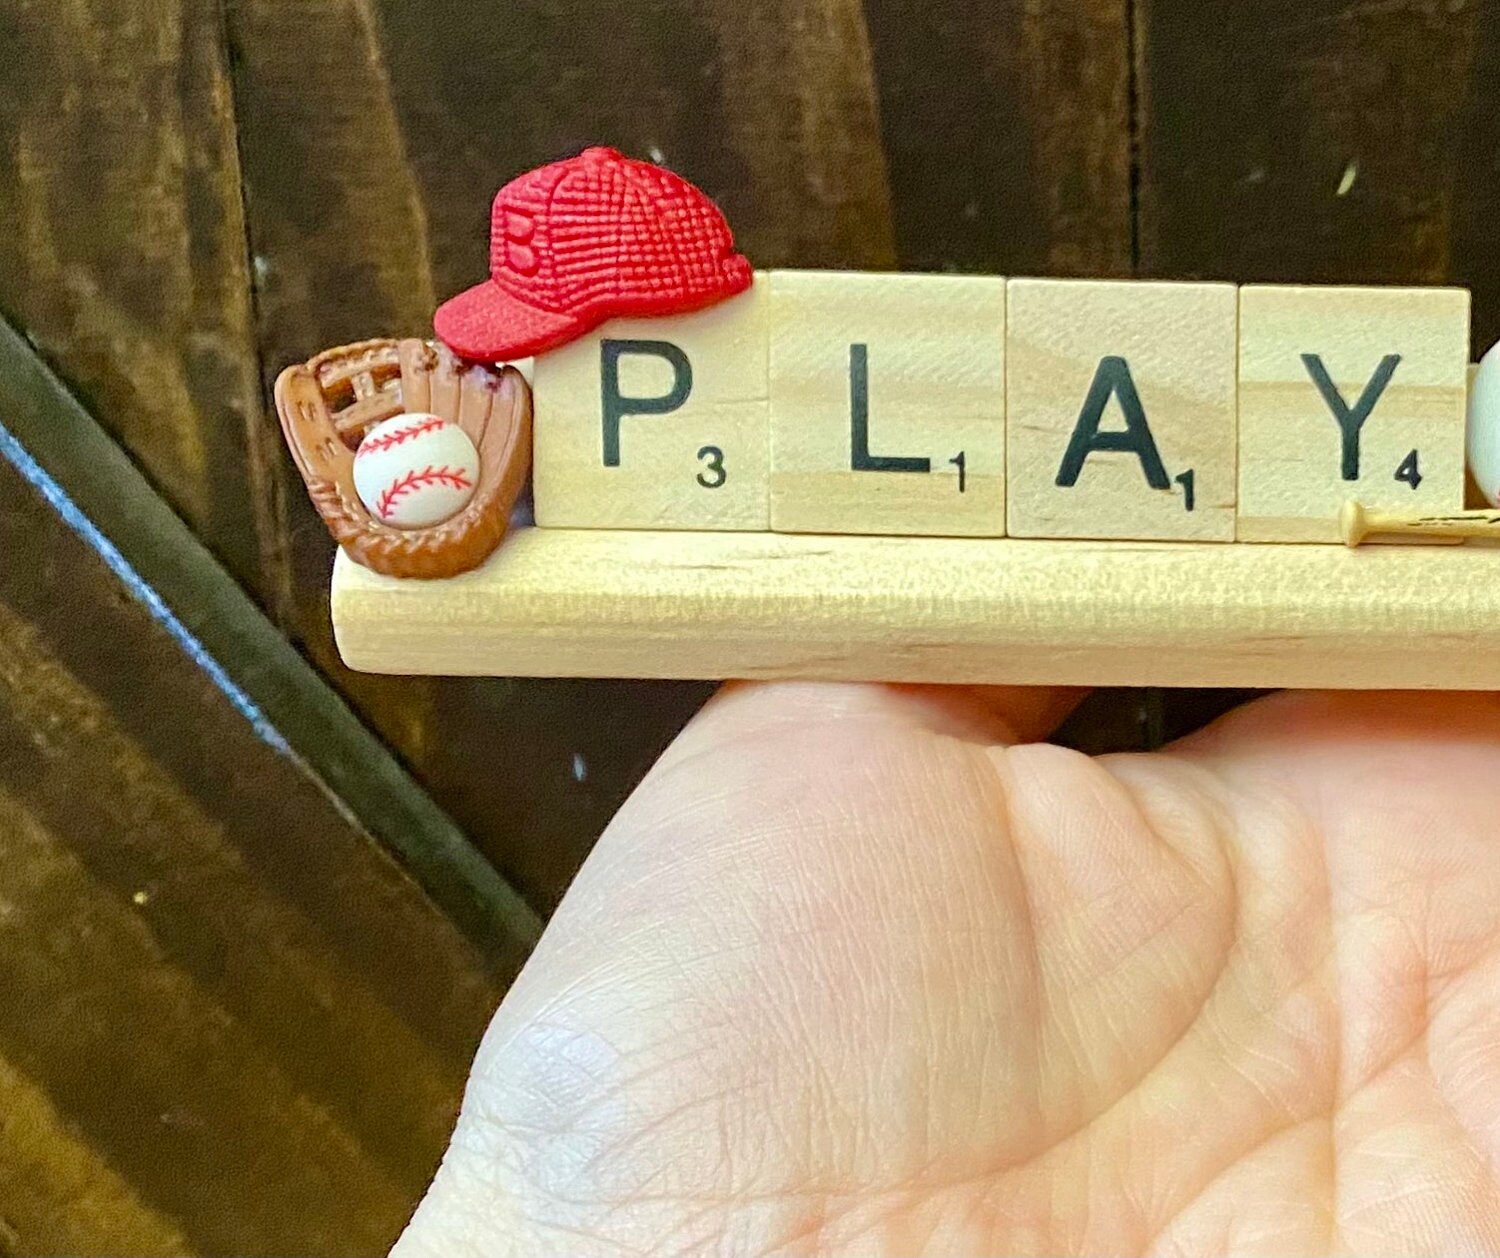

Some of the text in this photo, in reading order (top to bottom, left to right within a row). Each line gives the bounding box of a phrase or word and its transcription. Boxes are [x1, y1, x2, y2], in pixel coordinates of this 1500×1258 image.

[697, 446, 727, 489] 3
[949, 451, 966, 493] 1
[1394, 449, 1423, 490] 4
[1175, 468, 1195, 512] 1
